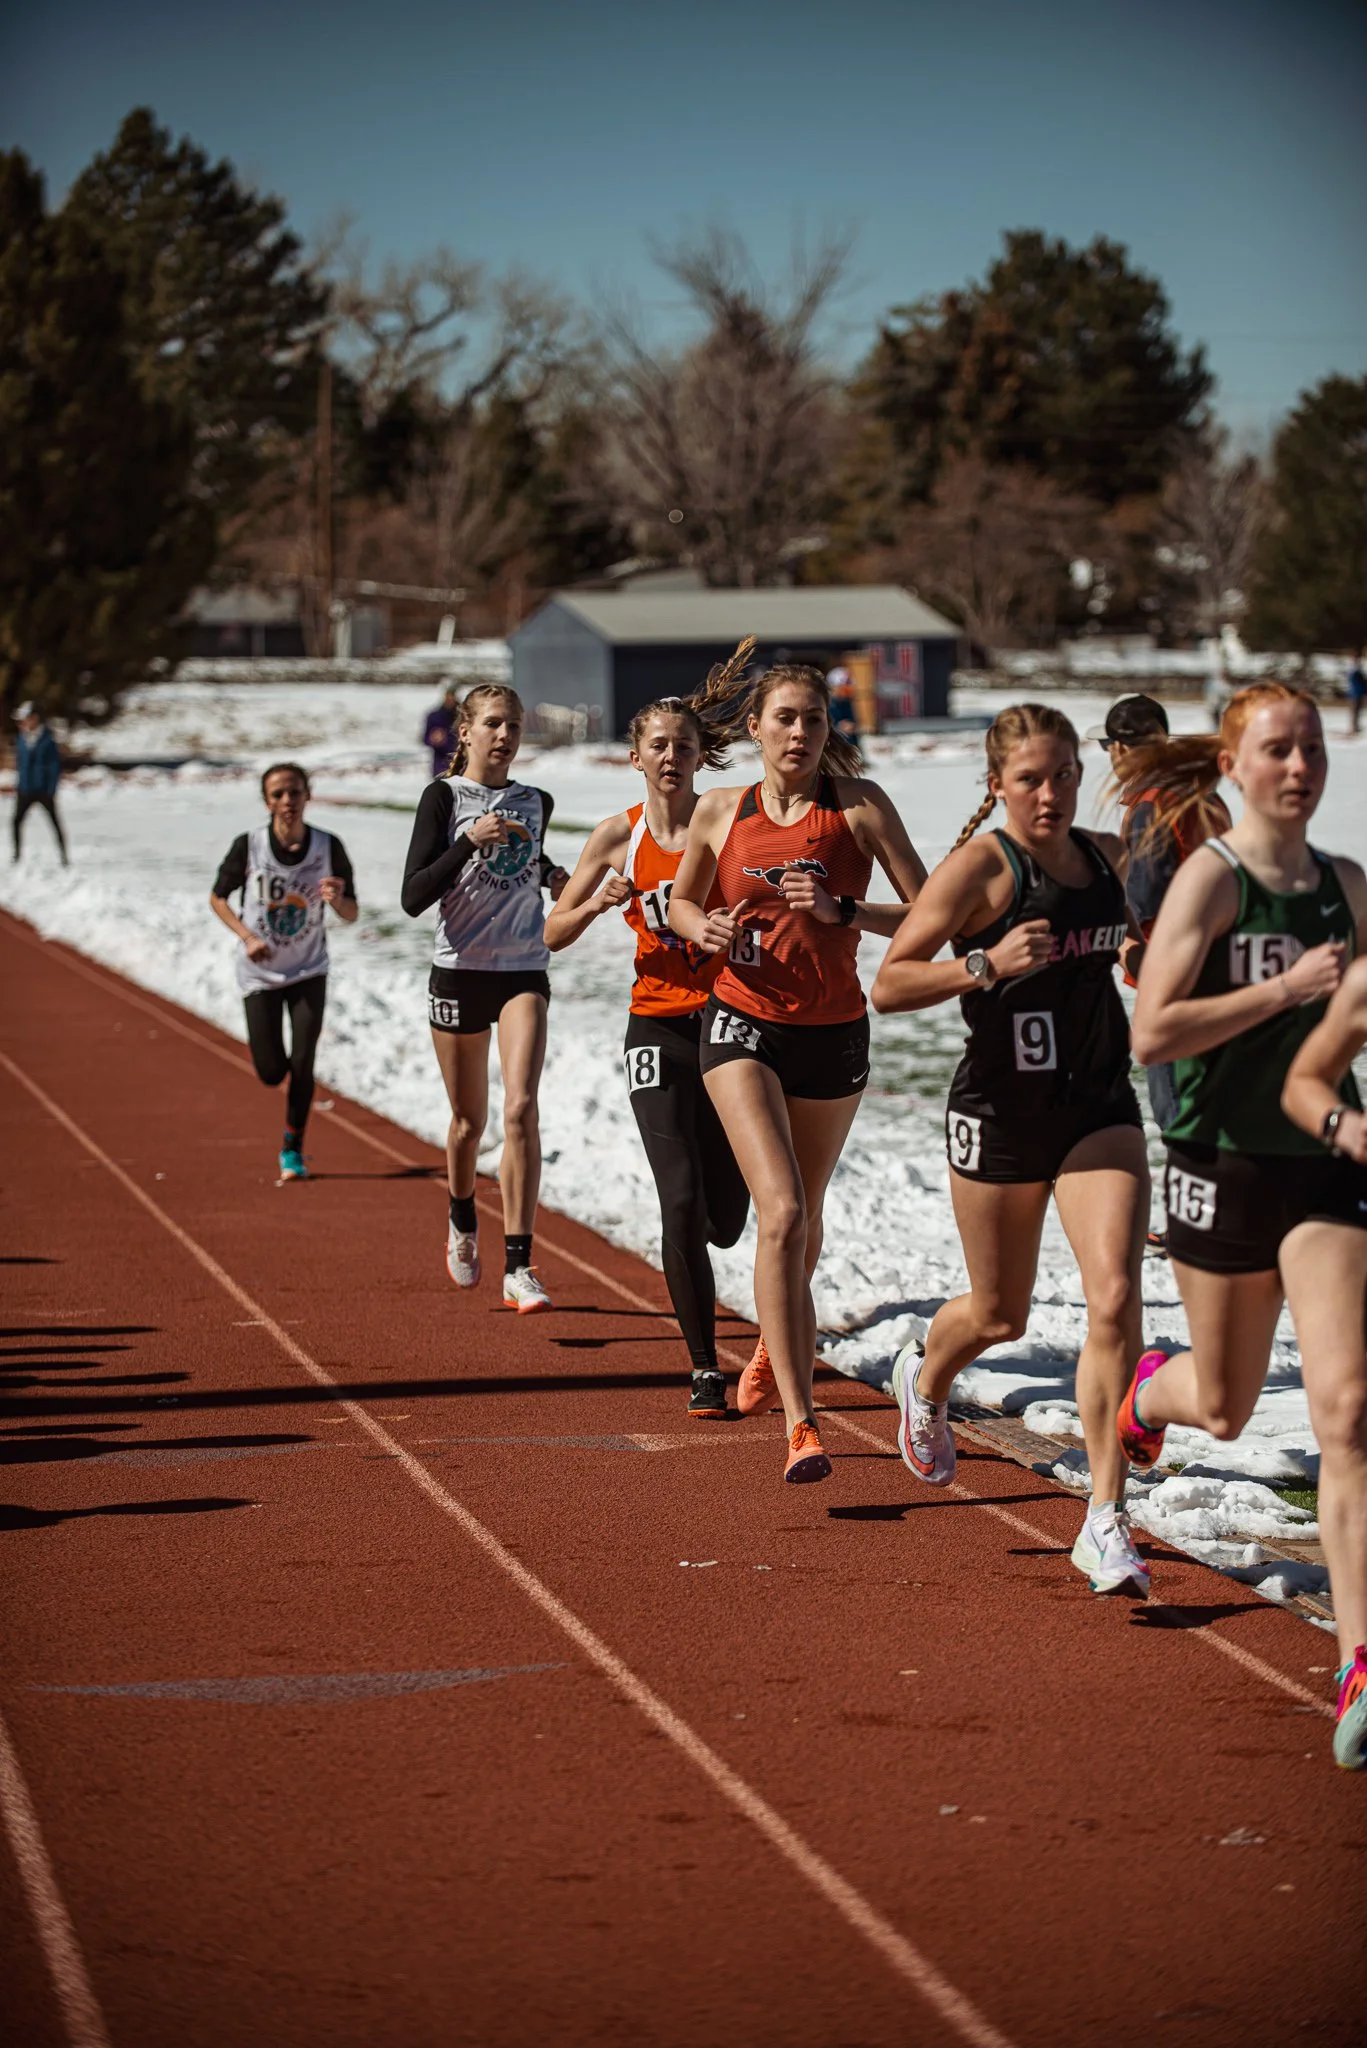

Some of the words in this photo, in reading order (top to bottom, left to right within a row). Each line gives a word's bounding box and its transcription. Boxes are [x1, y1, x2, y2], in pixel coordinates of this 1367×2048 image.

[256, 874, 286, 901] 16
[514, 857, 537, 888] TEAM
[1234, 936, 1285, 984] 15
[430, 997, 453, 1025] 10
[718, 1013, 754, 1045] 13
[1021, 1015, 1052, 1066] 9
[625, 1047, 656, 1091] 18
[955, 1118, 974, 1167] 9
[1172, 1174, 1205, 1223] 15
